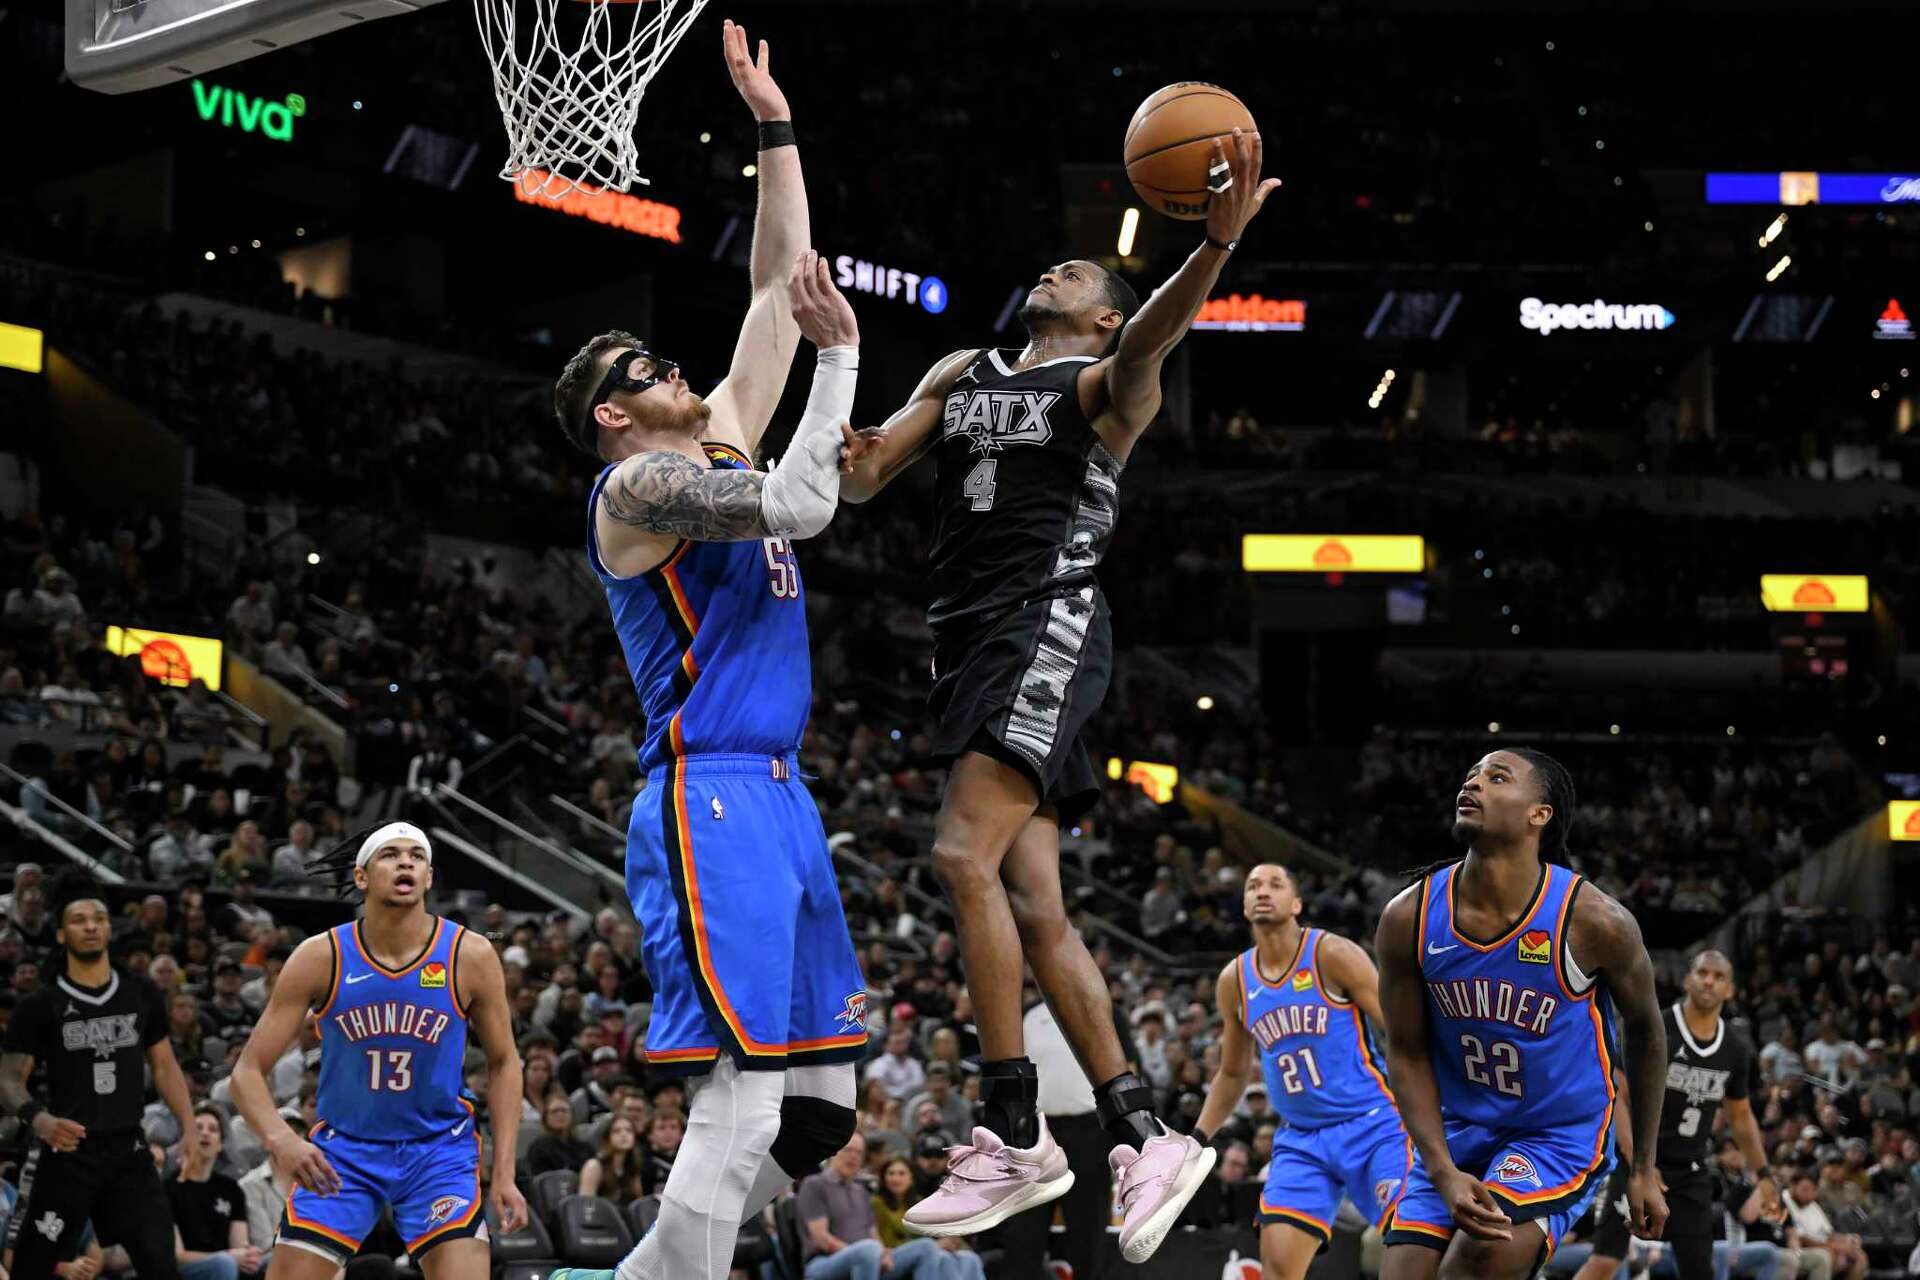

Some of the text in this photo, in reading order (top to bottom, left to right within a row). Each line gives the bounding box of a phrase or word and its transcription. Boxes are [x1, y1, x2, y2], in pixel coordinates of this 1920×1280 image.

[1520, 297, 1666, 336] Spectrum
[944, 390, 1062, 446] SATX
[963, 459, 997, 511] 4
[335, 1003, 449, 1044] THUNDER
[1251, 1005, 1328, 1050] THUNDER
[1427, 979, 1557, 1034] THUNDER
[93, 1061, 116, 1094] 5
[366, 1050, 413, 1091] 13
[1278, 1047, 1321, 1094] 21
[1461, 1034, 1523, 1097] 22
[1678, 1107, 1702, 1137] 3
